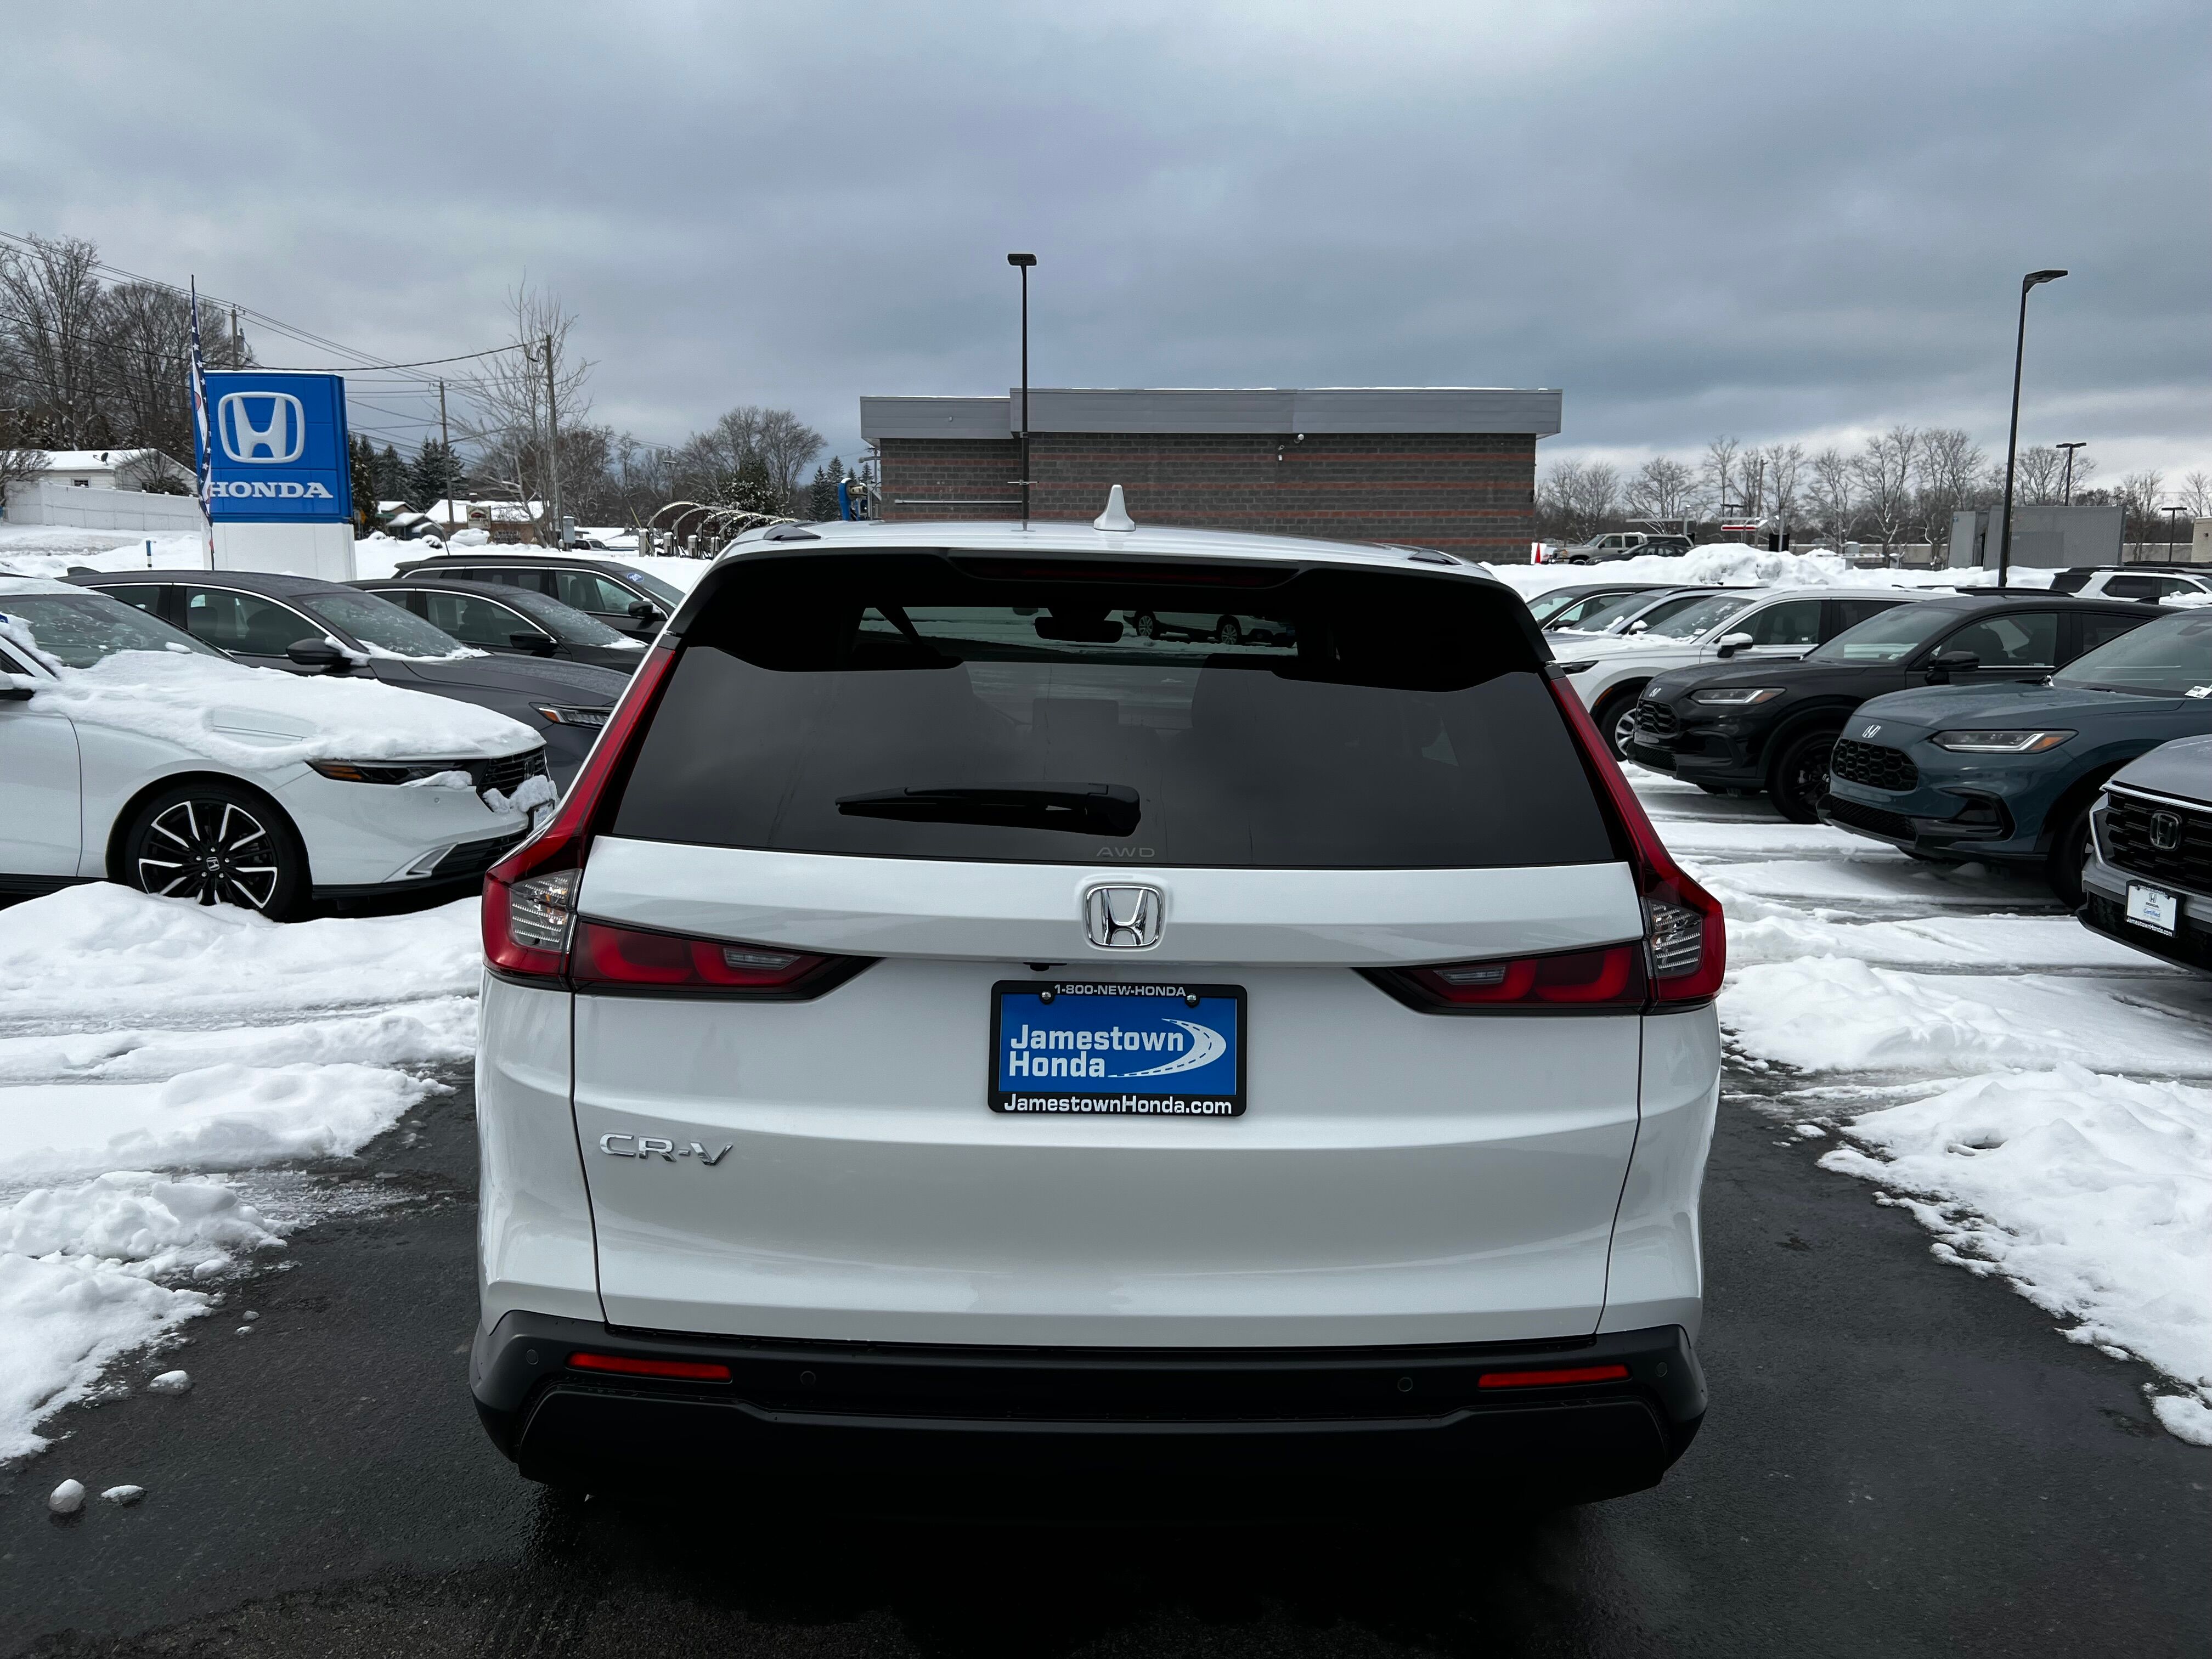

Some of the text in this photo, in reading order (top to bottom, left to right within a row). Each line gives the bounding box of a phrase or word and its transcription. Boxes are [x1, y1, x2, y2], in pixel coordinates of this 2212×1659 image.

[210, 481, 334, 499] HONDA
[1097, 847, 1155, 857] AWD
[2143, 908, 2160, 918] Certified
[1054, 984, 1186, 997] 1-800-NEW-HONDA
[1011, 1024, 1184, 1051] Jamestown
[1009, 1051, 1105, 1077] Honda
[1004, 1093, 1232, 1114] JamestownHonda.com
[600, 1132, 733, 1166] CR-V
